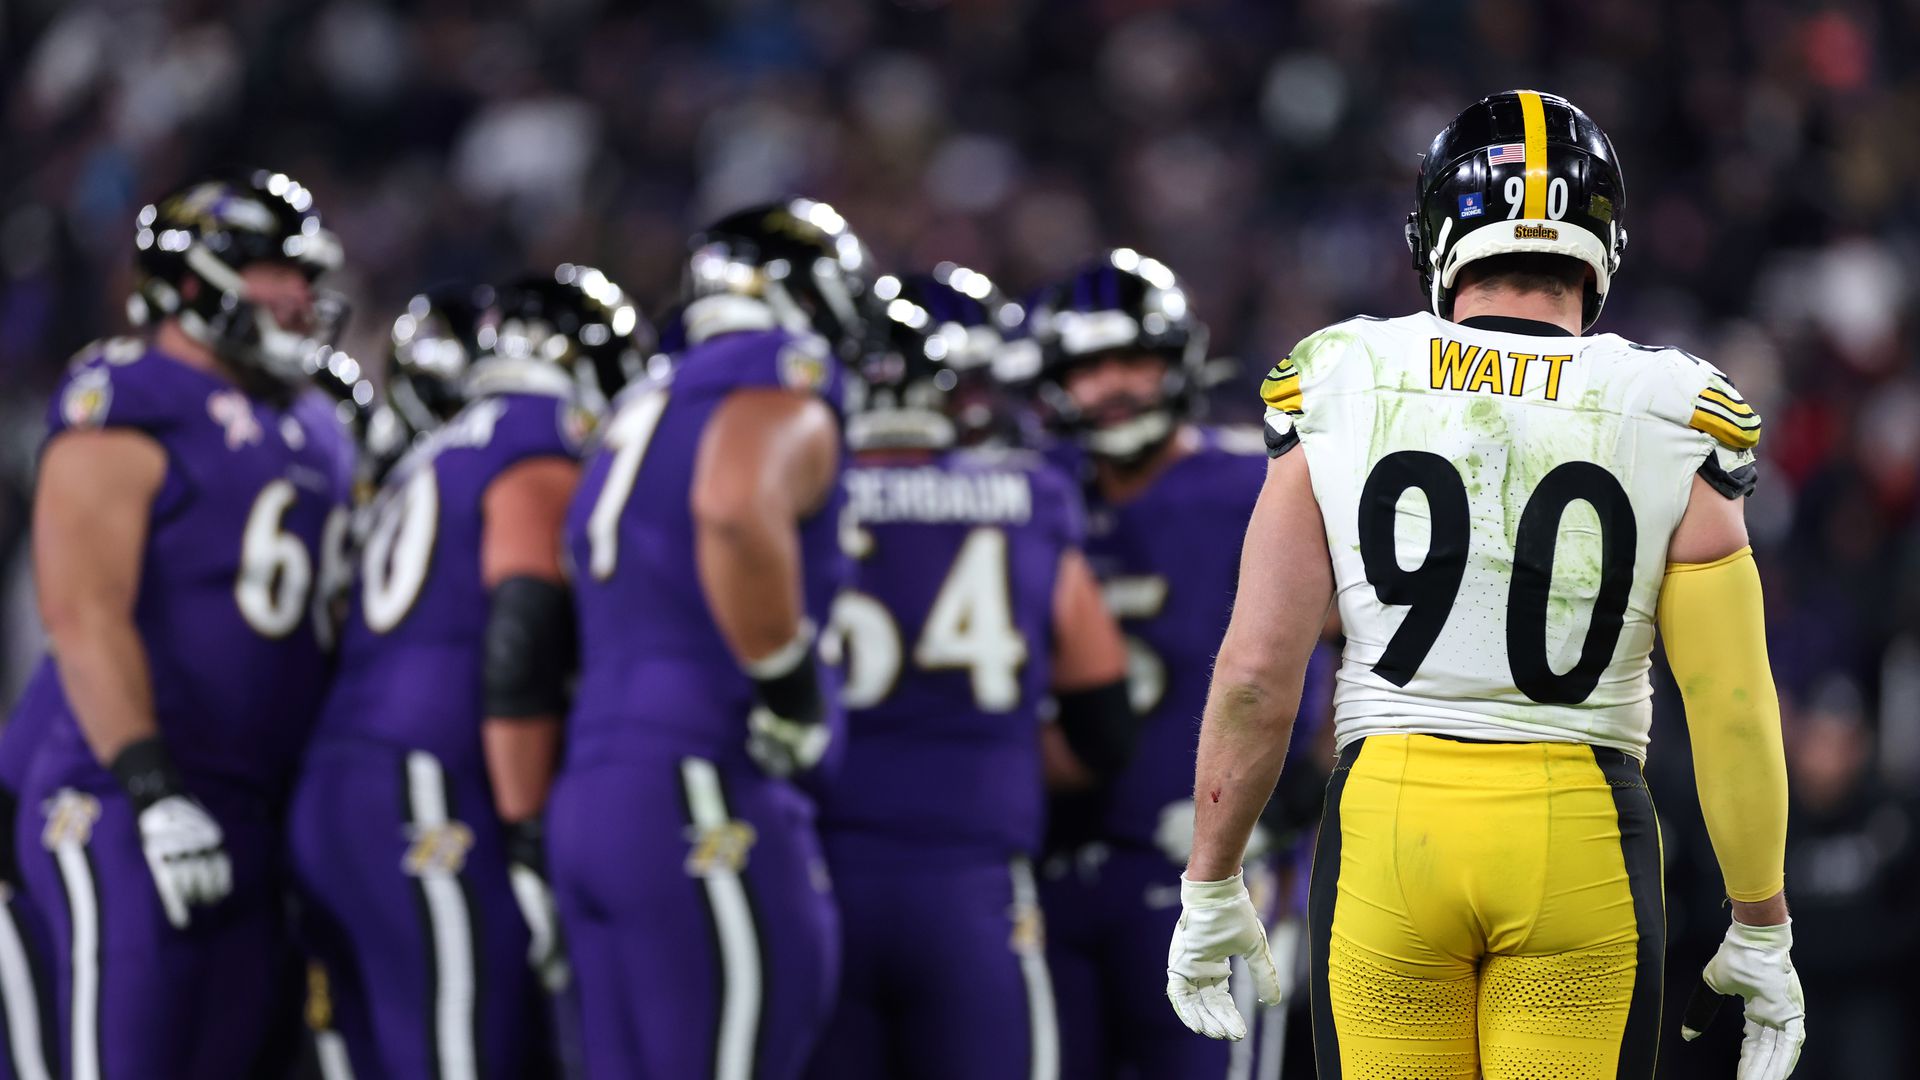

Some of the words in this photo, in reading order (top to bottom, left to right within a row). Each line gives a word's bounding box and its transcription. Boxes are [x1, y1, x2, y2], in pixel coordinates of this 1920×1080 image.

[1504, 176, 1569, 221] 90
[1514, 223, 1559, 241] Steelers
[1430, 337, 1573, 402] WATT
[1358, 450, 1637, 704] 90
